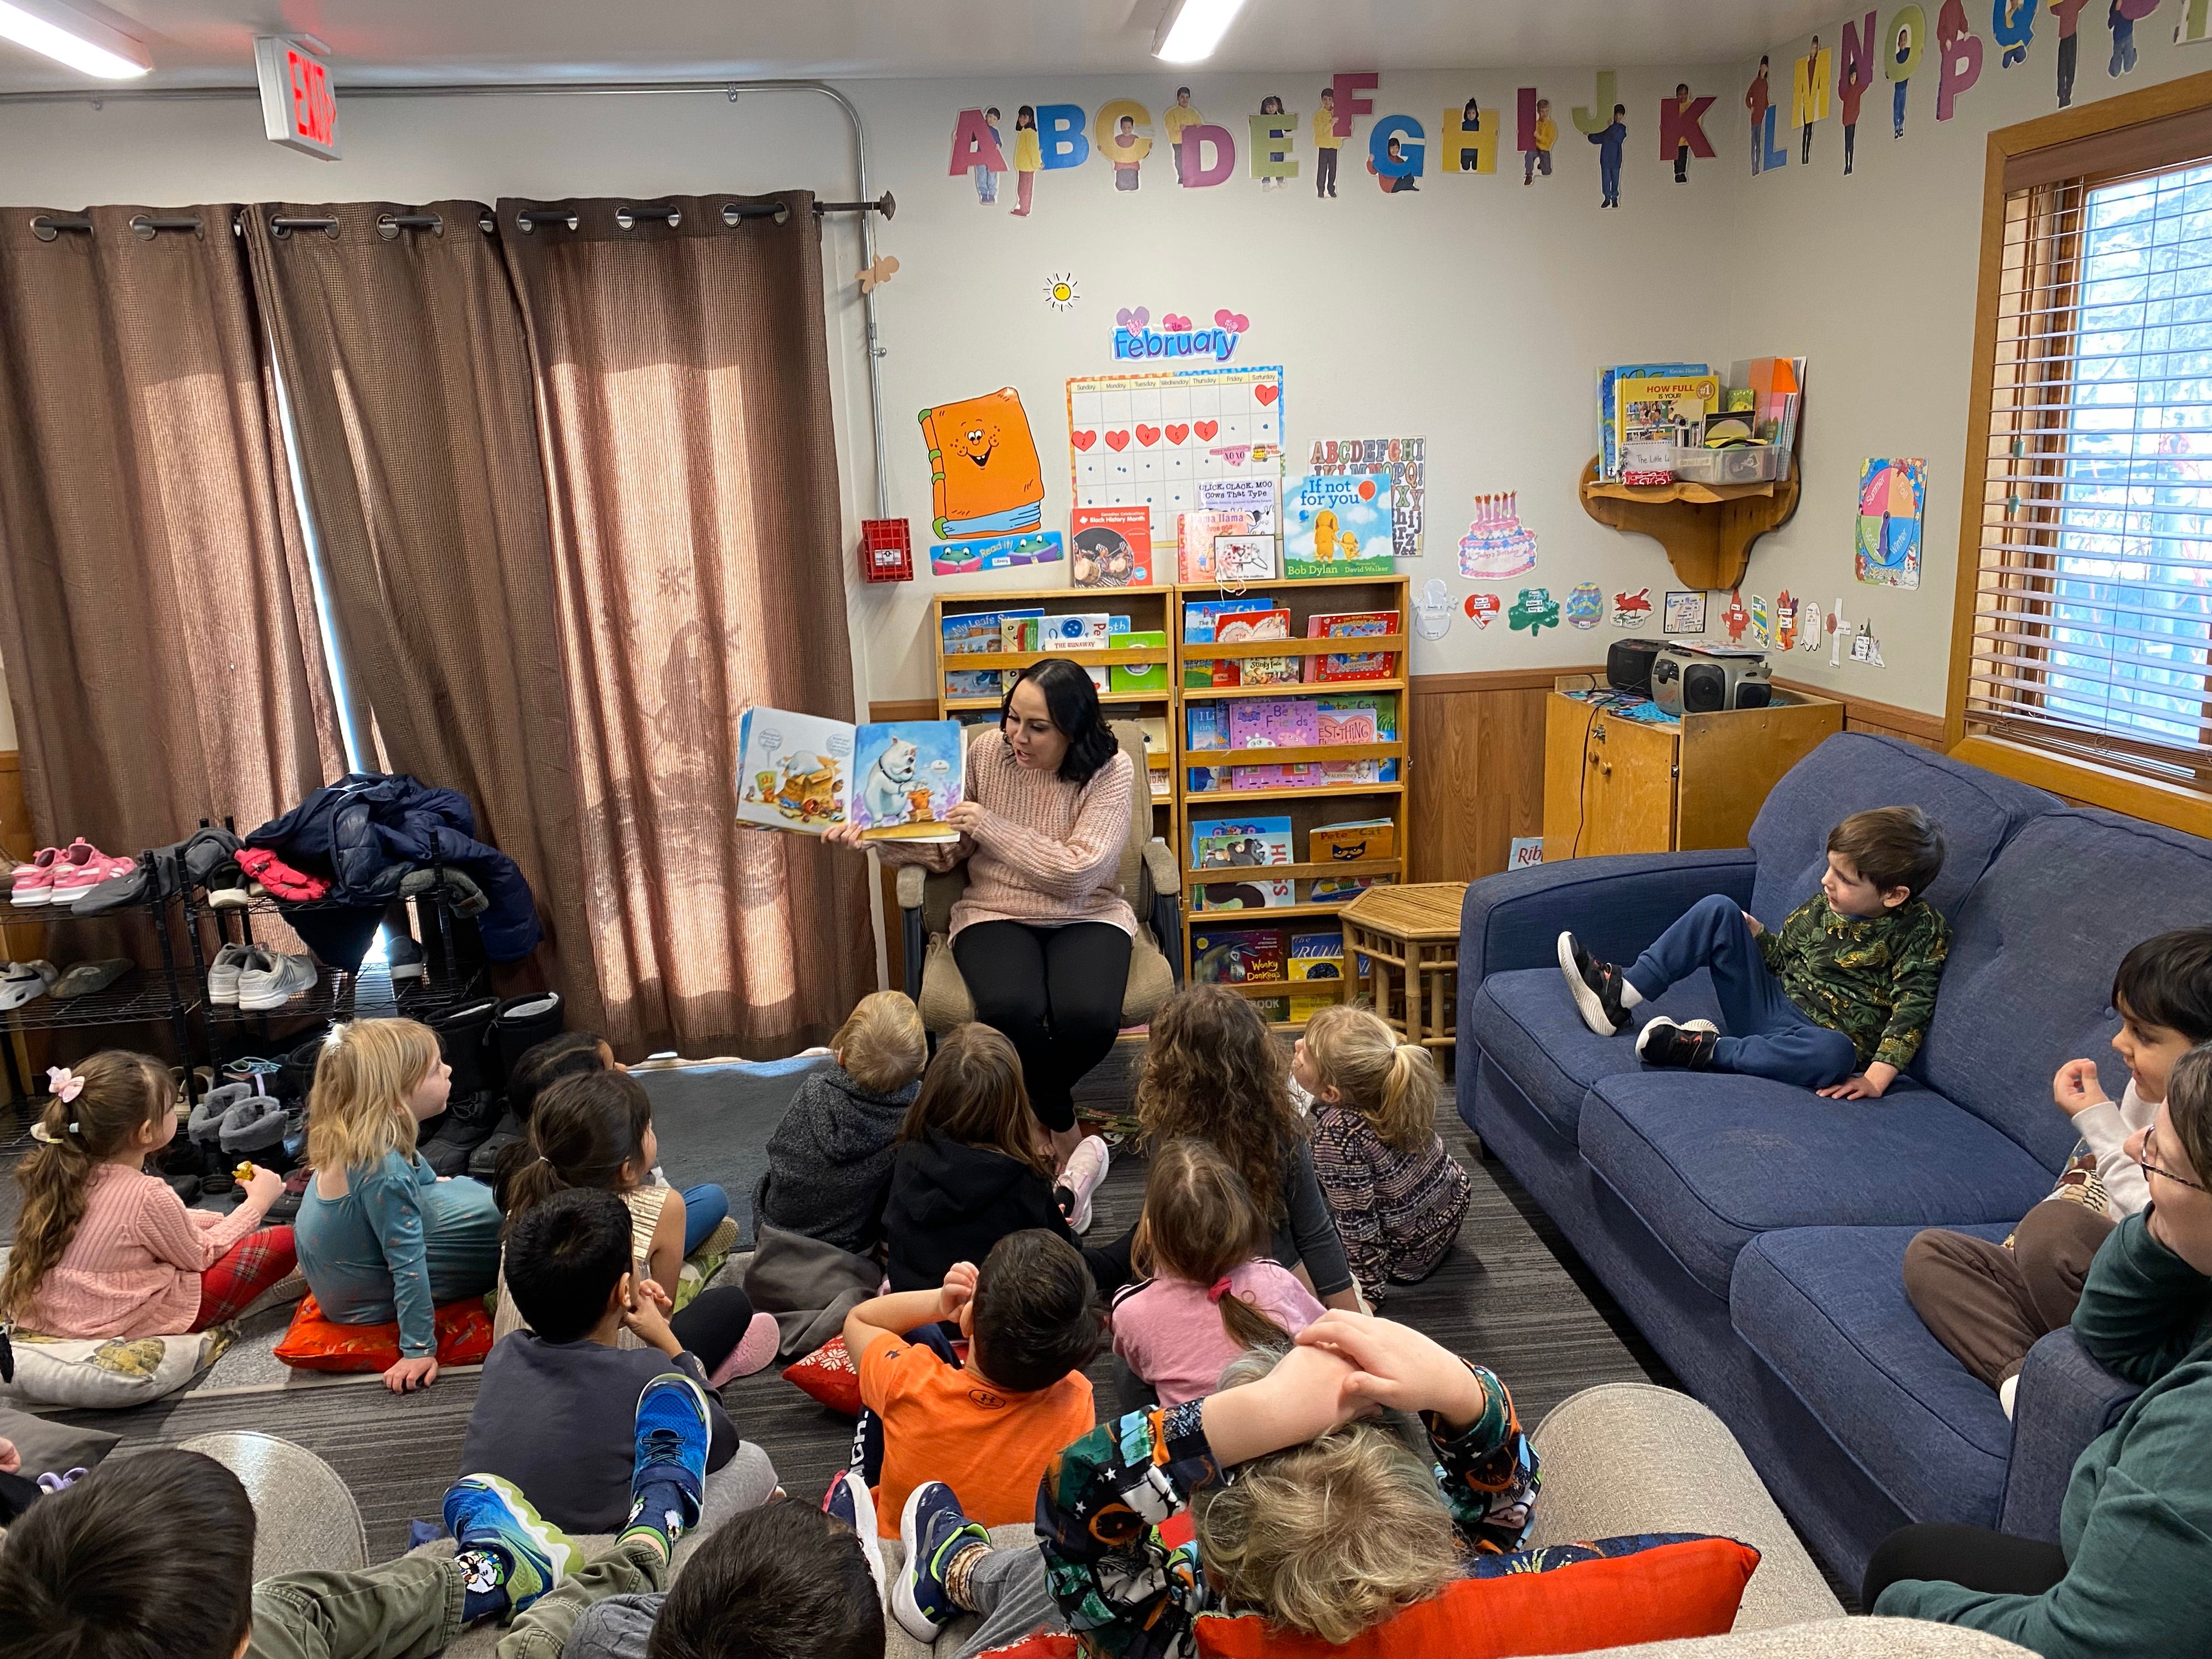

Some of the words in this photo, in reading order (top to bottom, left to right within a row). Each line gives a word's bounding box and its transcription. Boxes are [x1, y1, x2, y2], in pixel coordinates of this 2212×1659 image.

[1763, 105, 1787, 172] L
[1792, 47, 1831, 128] M
[1841, 11, 1877, 86] N
[1884, 4, 1926, 82] O
[1939, 35, 1983, 121] P
[949, 109, 1009, 176] A
[1036, 105, 1090, 170] B
[1094, 100, 1153, 163] C
[1181, 125, 1236, 188] D
[1249, 114, 1299, 178] E
[1333, 72, 1378, 137] F
[1369, 115, 1425, 178] G
[1442, 109, 1499, 173] H
[1517, 88, 1537, 151] I
[1571, 71, 1616, 134] J
[1660, 96, 1718, 160] K
[1115, 329, 1237, 362] February
[1700, 384, 1711, 396] #1
[1637, 454, 1647, 464] The
[1650, 454, 1663, 462] Little
[1199, 483, 1224, 492] CLICK,
[1226, 482, 1254, 490] CLACK,
[1309, 479, 1322, 493] If
[1325, 480, 1351, 493] not
[1866, 474, 1886, 506] Summer
[1897, 481, 1908, 500] Fall
[1248, 489, 1267, 499] Type
[1301, 490, 1325, 505] for
[1329, 494, 1359, 509] you
[1219, 514, 1243, 523] llama
[1866, 527, 1878, 556] Spring
[1889, 527, 1907, 555] Winter
[980, 540, 1002, 558] Read
[1288, 565, 1307, 575] Bob
[1309, 564, 1339, 576] Dylan
[1869, 564, 1902, 579] Seasons
[952, 622, 968, 635] My
[968, 615, 995, 628] Leafs
[1250, 661, 1269, 670] Stinky
[1273, 704, 1299, 717] Best
[1357, 700, 1376, 709] Cat
[1266, 715, 1308, 727] Friends
[1321, 832, 1348, 840] Pete
[1358, 827, 1383, 836] Cat
[1251, 959, 1278, 972] Wonky
